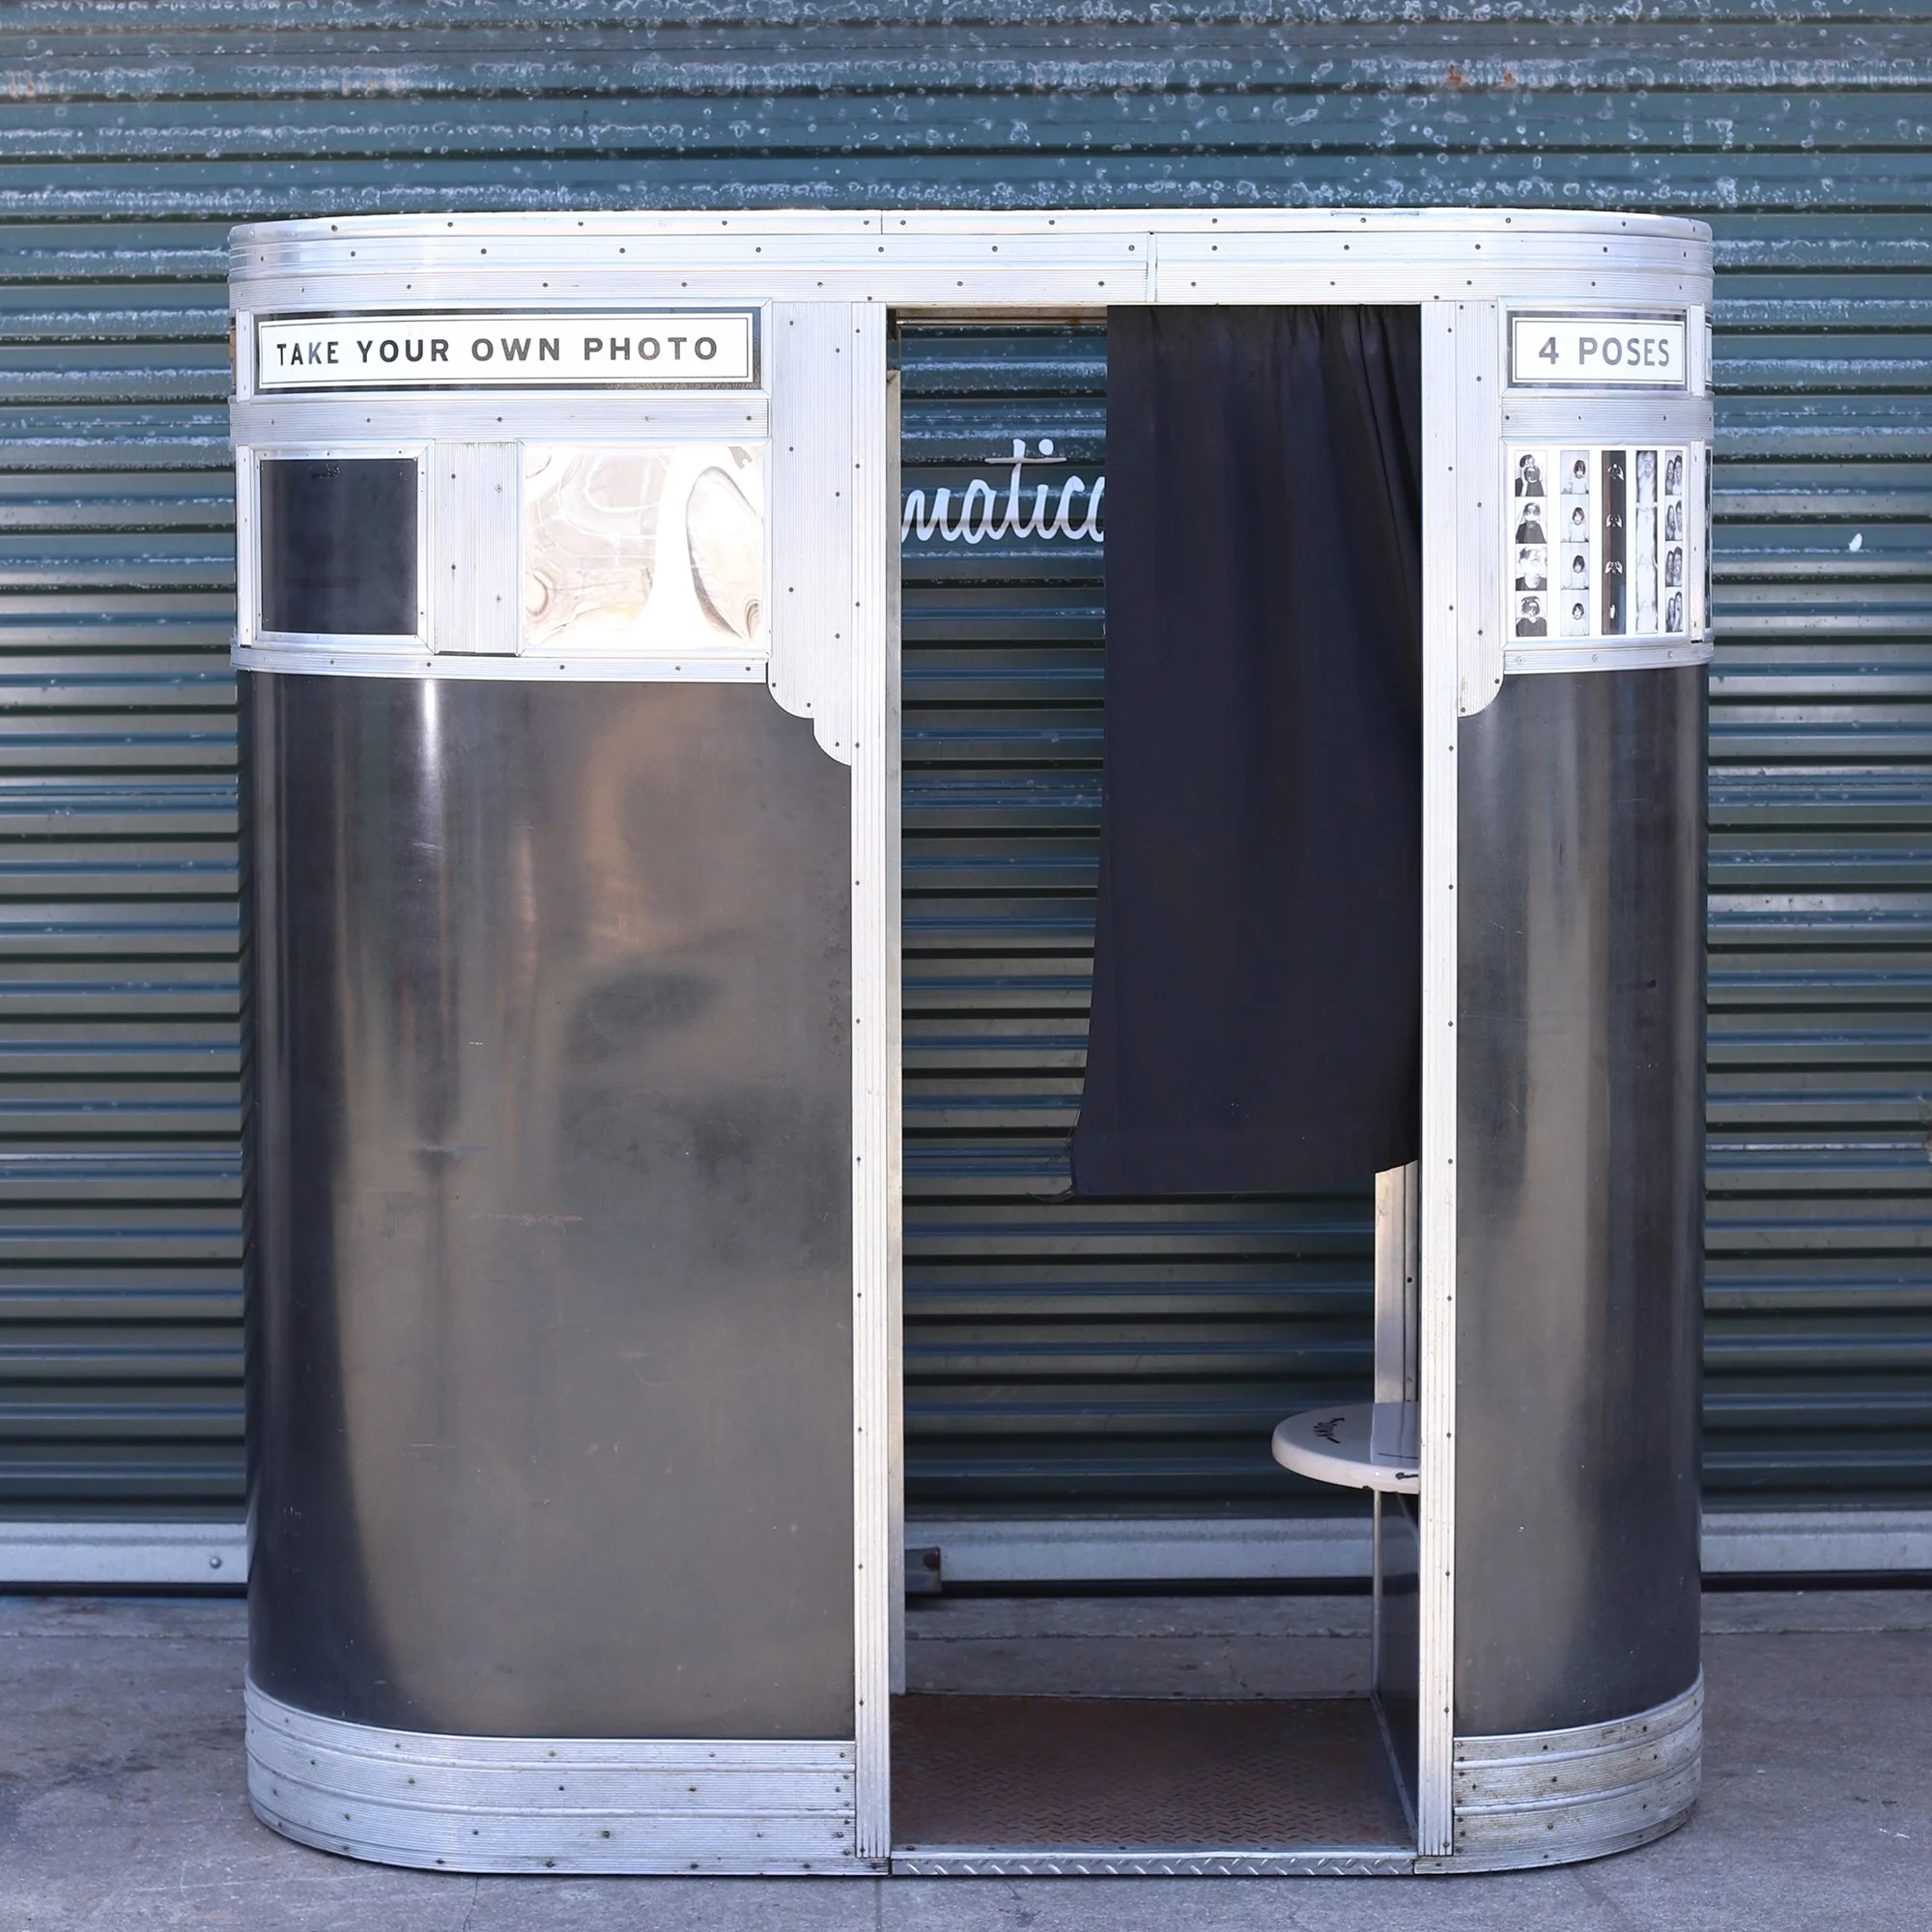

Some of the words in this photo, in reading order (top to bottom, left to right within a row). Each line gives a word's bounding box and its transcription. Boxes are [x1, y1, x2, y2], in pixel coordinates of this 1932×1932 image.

[276, 340, 339, 367] TAKE
[355, 338, 449, 363] YOUR
[470, 337, 560, 362] OWN
[583, 336, 718, 361] PHOTO
[1538, 336, 1560, 365] 4
[1578, 336, 1670, 367] POSES
